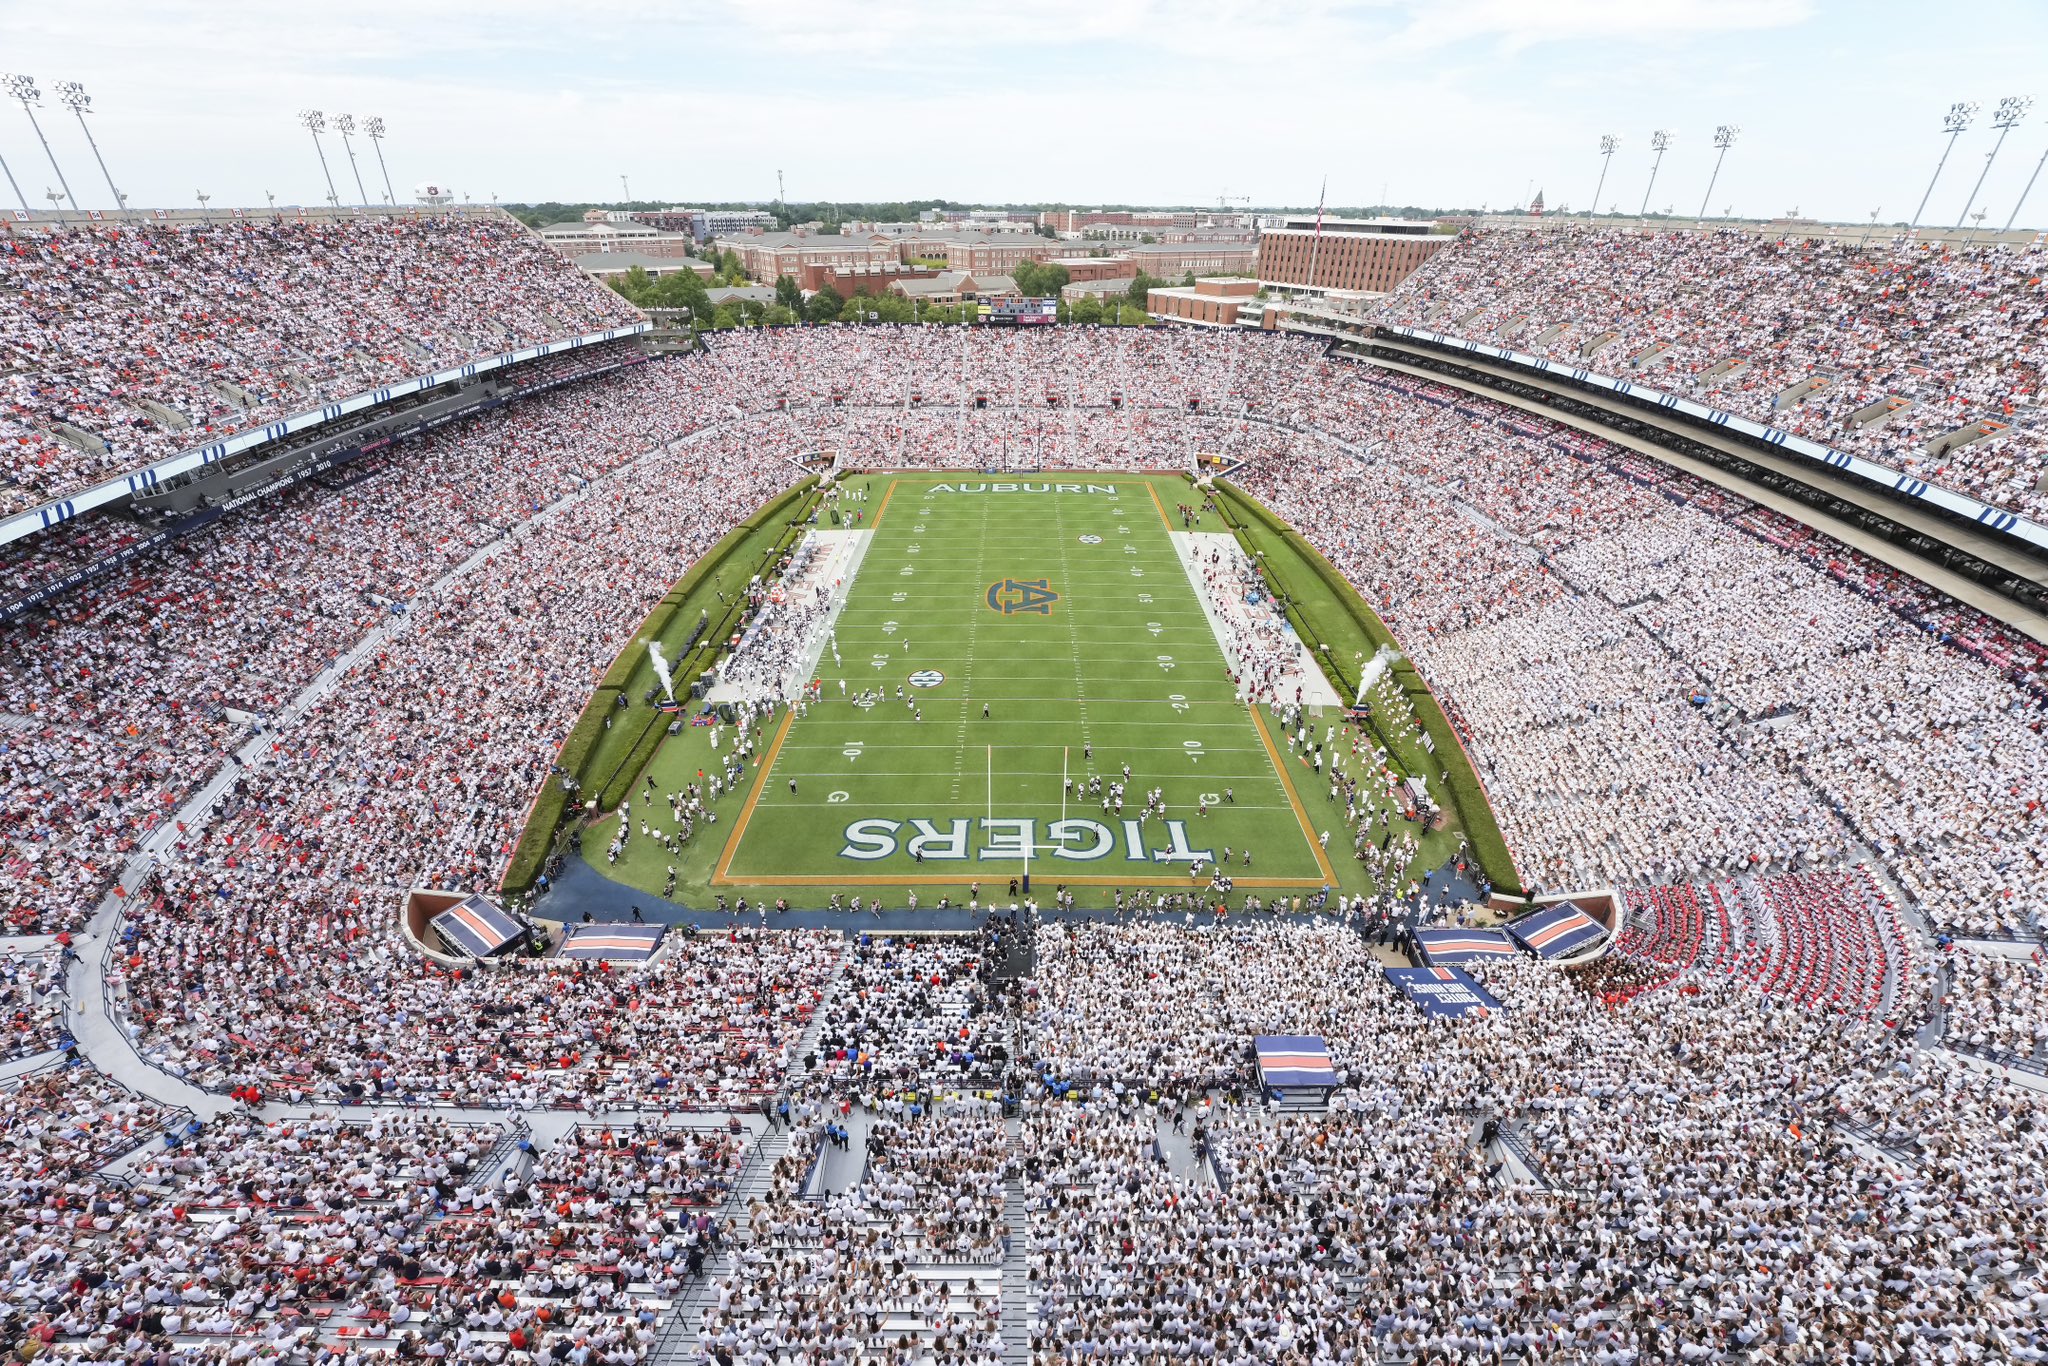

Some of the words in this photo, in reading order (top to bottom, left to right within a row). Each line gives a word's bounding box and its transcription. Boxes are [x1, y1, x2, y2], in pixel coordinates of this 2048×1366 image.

[222, 491, 257, 512] NATIONAL
[256, 475, 294, 498] CHAMPIONS
[297, 467, 312, 480] 1957
[316, 460, 332, 472] 2010
[927, 483, 1118, 494] AUBURN
[6, 602, 24, 614] 1904
[27, 591, 44, 603] 1913
[47, 582, 64, 593] 1914
[66, 573, 83, 584] 1932
[85, 564, 99, 575] 1957
[120, 548, 134, 558] 1993
[136, 540, 150, 551] 2004
[153, 533, 166, 544] 2010
[871, 654, 889, 667] 30
[1157, 655, 1175, 668] 30
[1169, 694, 1189, 709] 20
[842, 741, 864, 756] 10
[1183, 741, 1205, 756] 10
[827, 790, 849, 803] G
[1199, 793, 1220, 805] G
[836, 818, 1217, 864] TIGERS
[1411, 983, 1447, 993] HOUSE
[1443, 983, 1472, 993] THIS
[1434, 992, 1482, 1003] PROTECT
